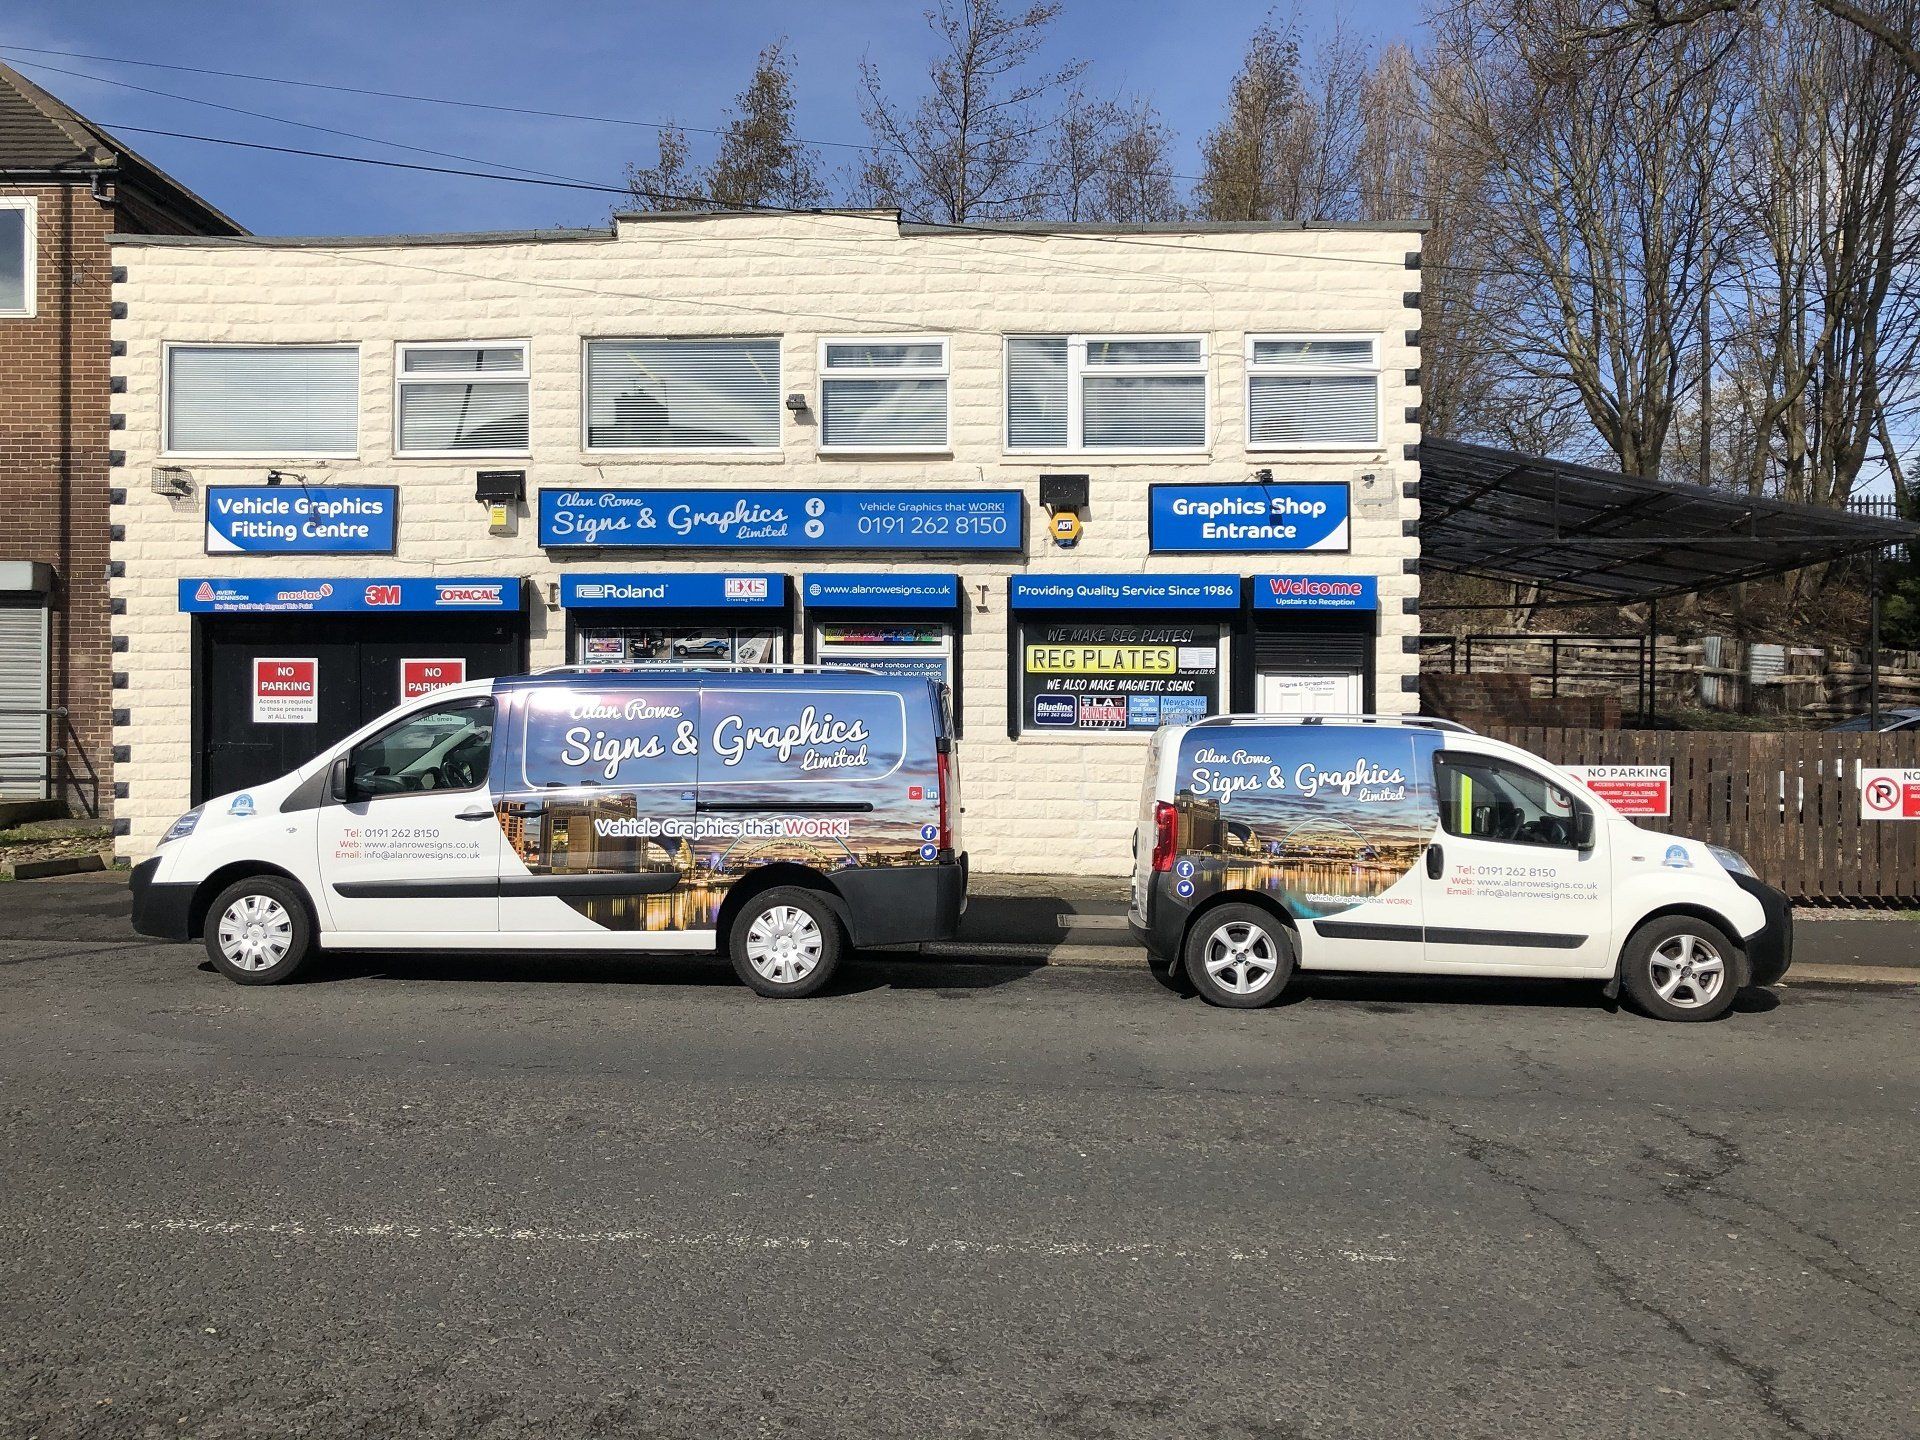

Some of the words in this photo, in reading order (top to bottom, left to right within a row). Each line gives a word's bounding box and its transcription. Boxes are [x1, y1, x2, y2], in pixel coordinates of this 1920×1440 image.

[556, 492, 597, 508] Alan
[599, 493, 644, 508] Rowe
[217, 497, 290, 514] Vehicle
[294, 497, 384, 518] Graphics
[859, 502, 896, 511] Vehicle
[899, 502, 942, 514] Graphics
[944, 502, 965, 511] that
[968, 502, 1005, 512] WORK!
[1172, 497, 1266, 518] Graphics
[1267, 497, 1327, 518] Shop
[552, 511, 631, 543] Signs
[636, 507, 657, 529] &
[668, 499, 789, 536] Graphics
[857, 516, 905, 534] 0191
[911, 516, 949, 534] 262
[955, 516, 1007, 534] 8150
[1058, 521, 1072, 530] ADT
[231, 521, 297, 541] Fitting
[302, 521, 369, 537] Centre
[1202, 522, 1297, 539] Entrance
[604, 584, 665, 599] Roland
[727, 579, 765, 596] HEXIS
[824, 585, 950, 596] www.alanrowesigns.co.uk
[1018, 585, 1074, 598] Providing
[1076, 585, 1120, 598] Quality
[1122, 585, 1166, 596] Service
[1168, 585, 1200, 596] Since
[1203, 585, 1234, 596] 1986
[1269, 578, 1363, 595] Welcome
[278, 590, 322, 601] mactac
[365, 585, 401, 605] 3M
[1318, 598, 1355, 606] Reception
[1047, 629, 1067, 642] WE
[1070, 629, 1107, 642] MAKE
[1111, 629, 1137, 642] REG
[1141, 629, 1194, 643] PLATES!
[925, 662, 942, 670] your
[1034, 649, 1076, 669] REG
[1083, 649, 1171, 670] PLATES
[277, 667, 294, 676] NO
[425, 667, 442, 677] NO
[261, 681, 311, 691] PARKING
[408, 682, 457, 692] PARKIN
[1047, 679, 1061, 690] WE
[1063, 679, 1087, 691] ALSO
[1089, 679, 1115, 691] MAKE
[1117, 680, 1165, 692] MAGNETIC
[1167, 680, 1195, 692] SIGNS
[1037, 702, 1073, 711] Blueline
[1093, 698, 1115, 706] LA
[1162, 698, 1206, 706] Newcastle
[569, 701, 622, 720] Alan
[624, 698, 684, 720] Rowe
[1081, 708, 1107, 719] PRIVATE
[1107, 708, 1124, 719] ONLY
[560, 726, 666, 779] Signs
[671, 720, 699, 756] &
[711, 705, 870, 766] Graphics
[1194, 748, 1230, 764] Alan
[1232, 749, 1273, 765] Rowe
[1587, 768, 1607, 778] NO
[1610, 768, 1668, 778] PARKING
[1903, 771, 1920, 780] NO
[1190, 768, 1262, 804] Signs
[1266, 765, 1286, 789] &
[1294, 757, 1406, 798] Graphics
[344, 829, 362, 838] Tel:
[364, 829, 389, 838] 0191
[391, 829, 410, 838] 262
[413, 829, 440, 838] 8150
[596, 818, 660, 837] Vehicle
[662, 818, 741, 839] Graphics
[745, 818, 781, 837] that
[785, 818, 849, 837] WORK!
[339, 840, 362, 849] Web:
[364, 840, 480, 850] www.alanrowesigns.co.uk
[335, 850, 362, 859] Email:
[364, 850, 480, 860] info@alanrowesigns.co.uk
[1456, 865, 1476, 875] Tel:
[1478, 866, 1503, 876] 0191
[1506, 867, 1526, 877] 262
[1529, 868, 1557, 878] 8150
[1451, 877, 1475, 886] Web:
[1477, 878, 1598, 890] www.alanrowesigns.co.uk
[1306, 894, 1333, 903] Vehicle
[1334, 894, 1367, 905] Graphics
[1368, 895, 1384, 904] that
[1385, 897, 1413, 906] WORK!
[1446, 887, 1475, 896] Email:
[1477, 888, 1599, 900] info@alanrowesigns.co.uk
